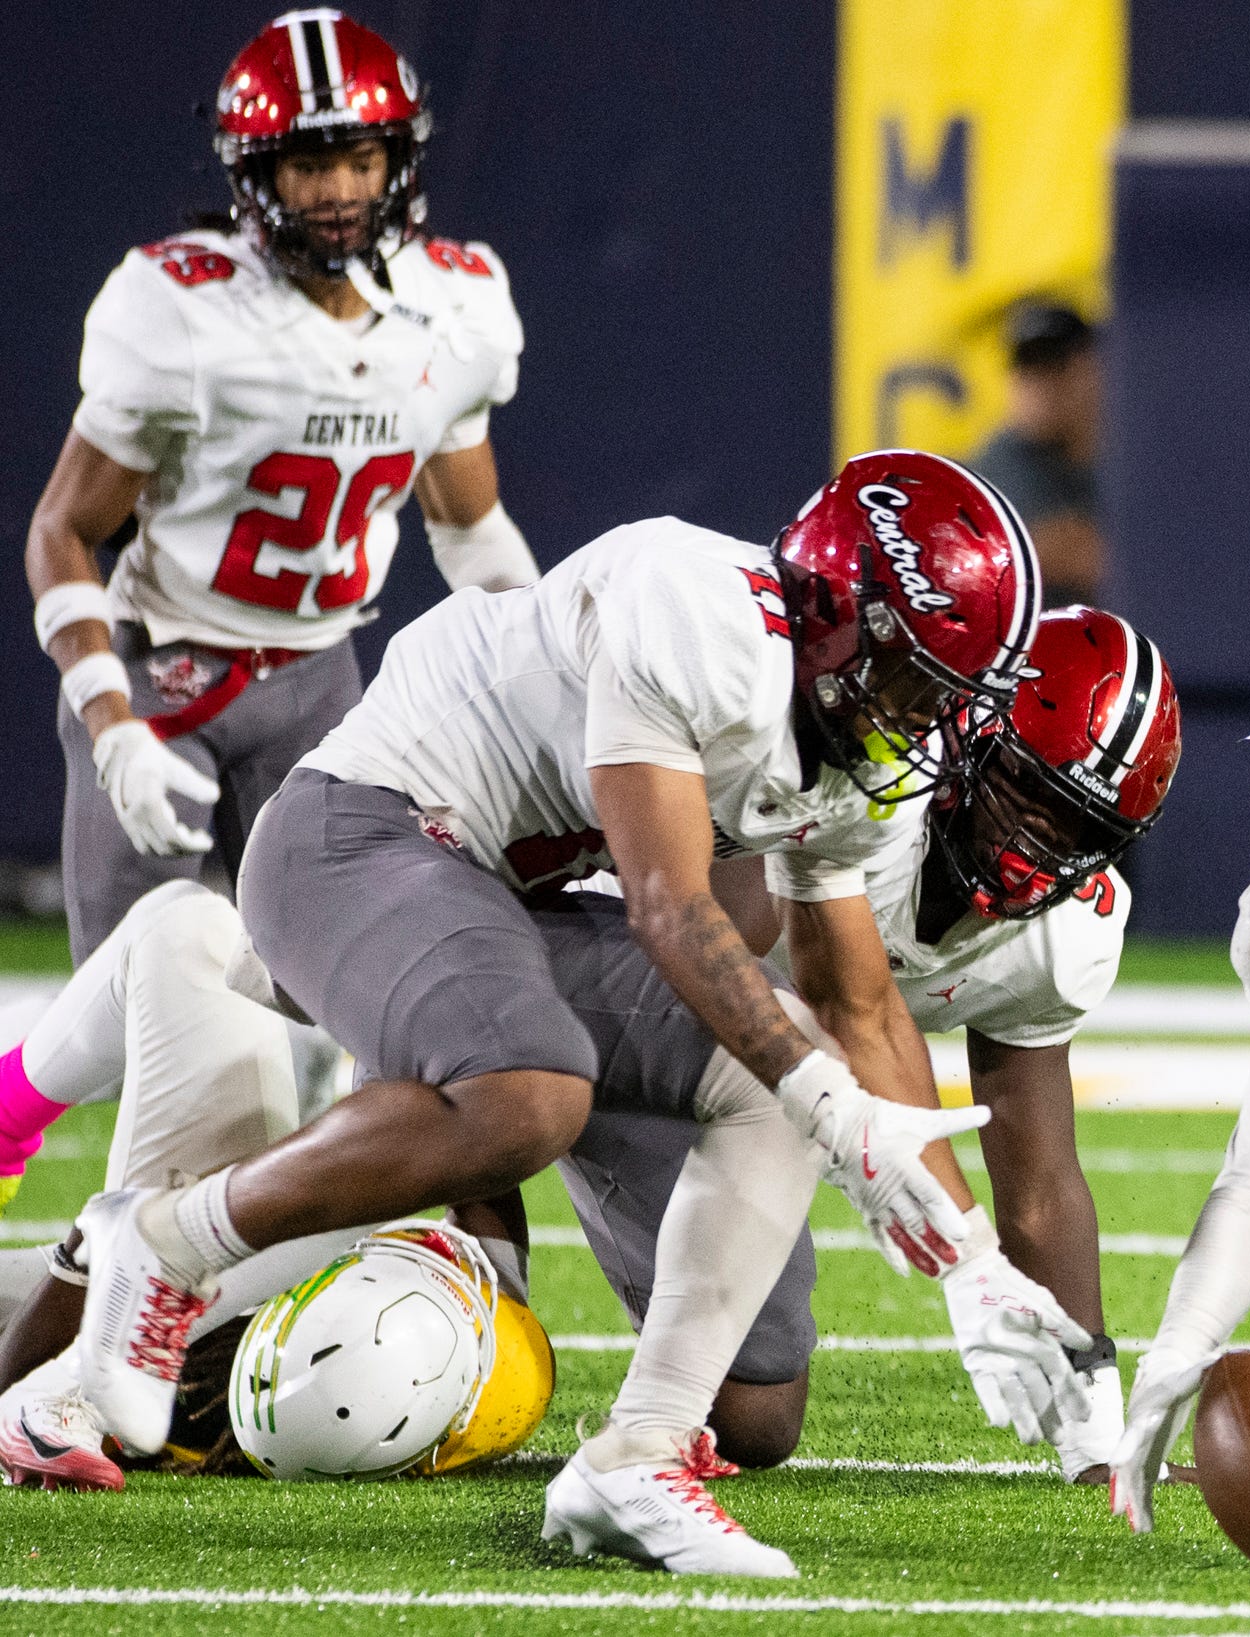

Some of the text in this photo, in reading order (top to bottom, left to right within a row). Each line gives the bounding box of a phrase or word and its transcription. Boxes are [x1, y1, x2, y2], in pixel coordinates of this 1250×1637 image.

[302, 411, 400, 446] CENTRAL
[856, 482, 955, 614] Central
[1068, 762, 1119, 804] Riddell
